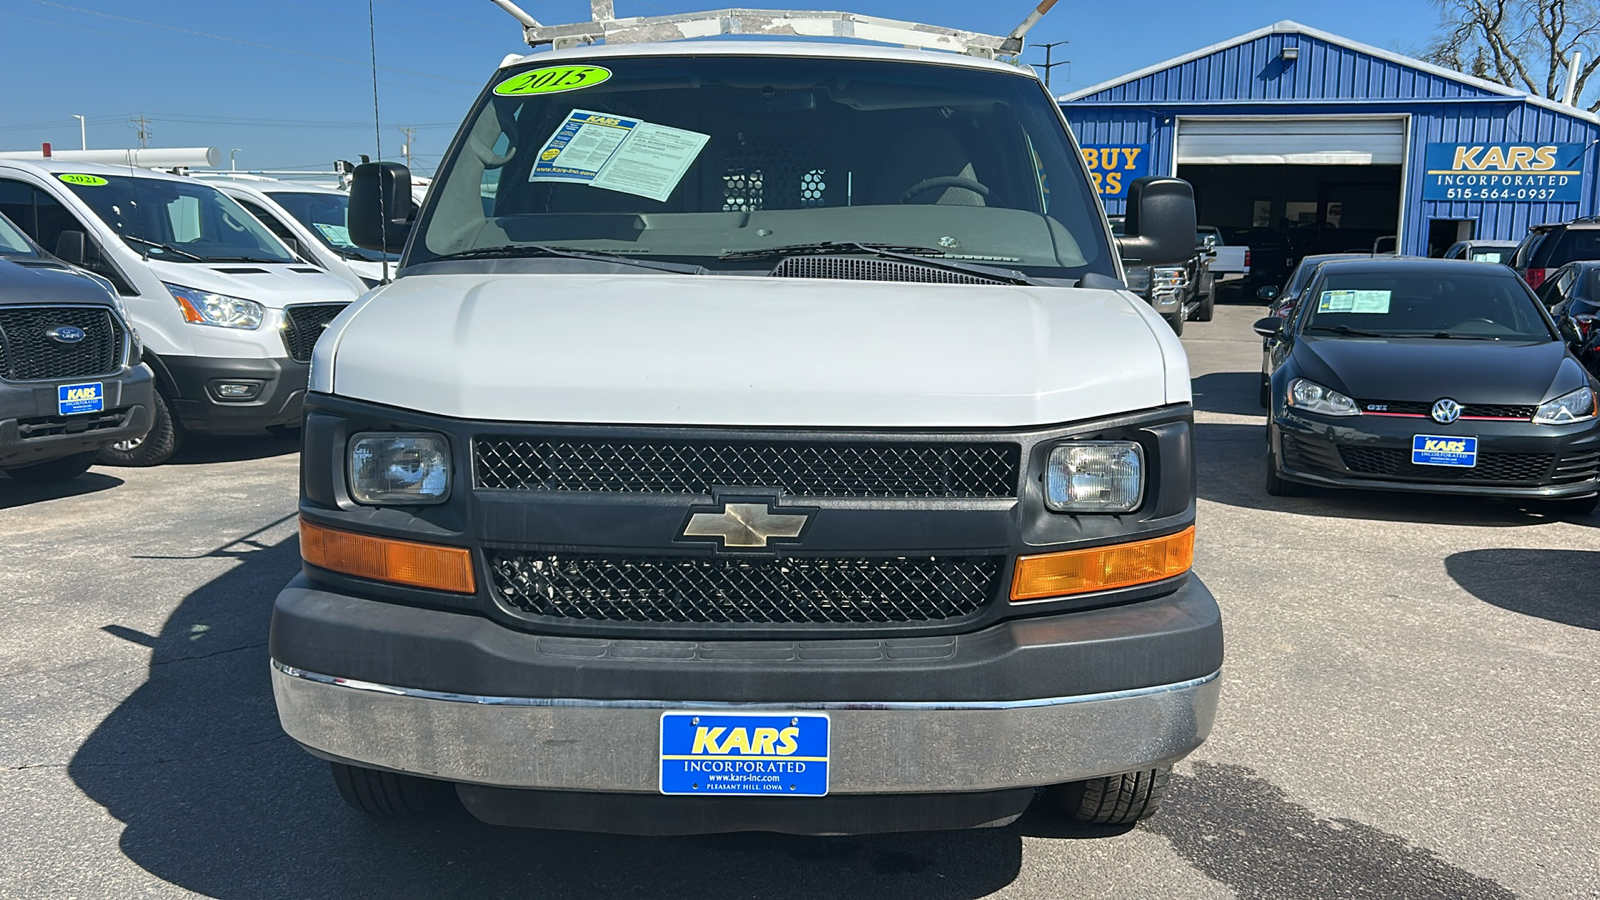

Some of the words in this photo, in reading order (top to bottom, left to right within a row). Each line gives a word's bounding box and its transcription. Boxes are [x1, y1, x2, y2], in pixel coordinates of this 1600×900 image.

[509, 68, 595, 92] 2015
[586, 115, 620, 126] KARS
[1080, 148, 1141, 170] BUY
[1452, 146, 1557, 171] KARS
[68, 175, 97, 183] 2021
[1091, 172, 1122, 194] RS
[1437, 175, 1569, 186] INCORPORATED
[1447, 188, 1556, 199] 515-564-0937
[67, 387, 96, 400] KARS
[1424, 440, 1466, 452] KARS
[691, 726, 800, 755] KARS
[684, 761, 806, 773] INCORPORATED
